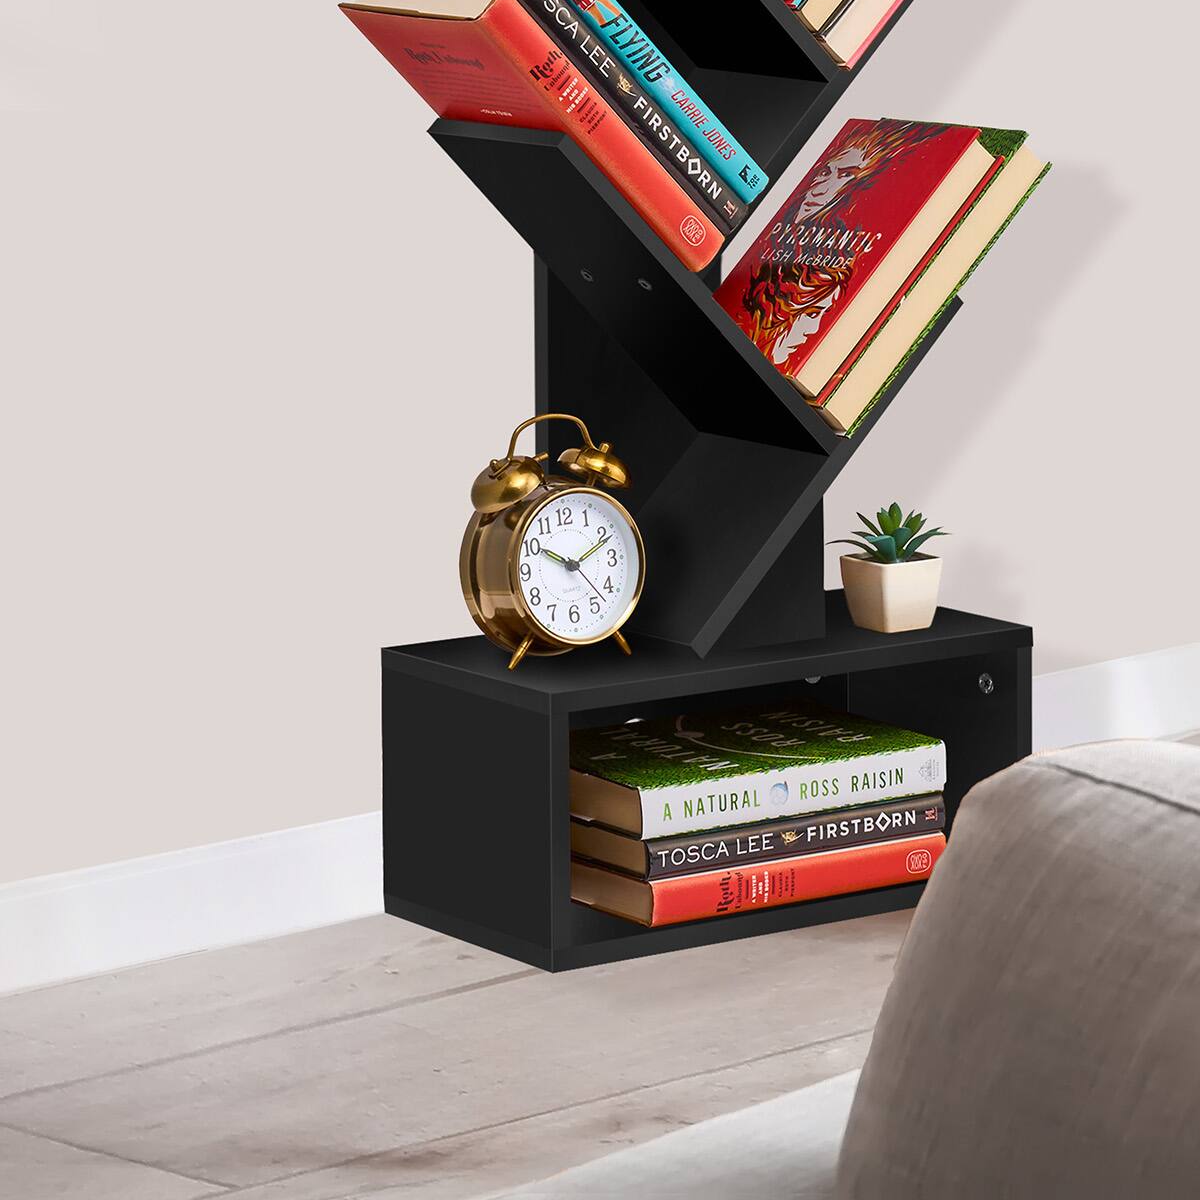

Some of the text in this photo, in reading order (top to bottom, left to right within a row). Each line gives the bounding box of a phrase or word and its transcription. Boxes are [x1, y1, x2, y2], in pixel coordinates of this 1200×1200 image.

[579, 35, 616, 78] LEE
[600, 13, 671, 83] FLYING
[670, 88, 737, 161] CARRIE JONES
[633, 96, 722, 200] FIRSTBORN
[765, 222, 882, 253] PYROMANTIC
[761, 247, 854, 270] LISH McBRIDE
[537, 516, 551, 535] 11
[556, 507, 573, 527] 12
[582, 510, 589, 527] 1
[597, 526, 608, 543] 2
[524, 538, 540, 557] 10
[607, 549, 618, 568] 3
[520, 563, 531, 581] 9
[603, 576, 614, 594] 4
[530, 587, 541, 606] 8
[590, 596, 601, 614] 5
[547, 604, 557, 622] 7
[569, 605, 580, 623] 6
[721, 722, 806, 747] ROSS
[800, 777, 840, 801] ROSS
[851, 767, 905, 793] RAISIN
[663, 788, 760, 822] A NATURAL
[806, 809, 917, 843] FIRSTBORN
[657, 833, 775, 868] TOSCA LEE
